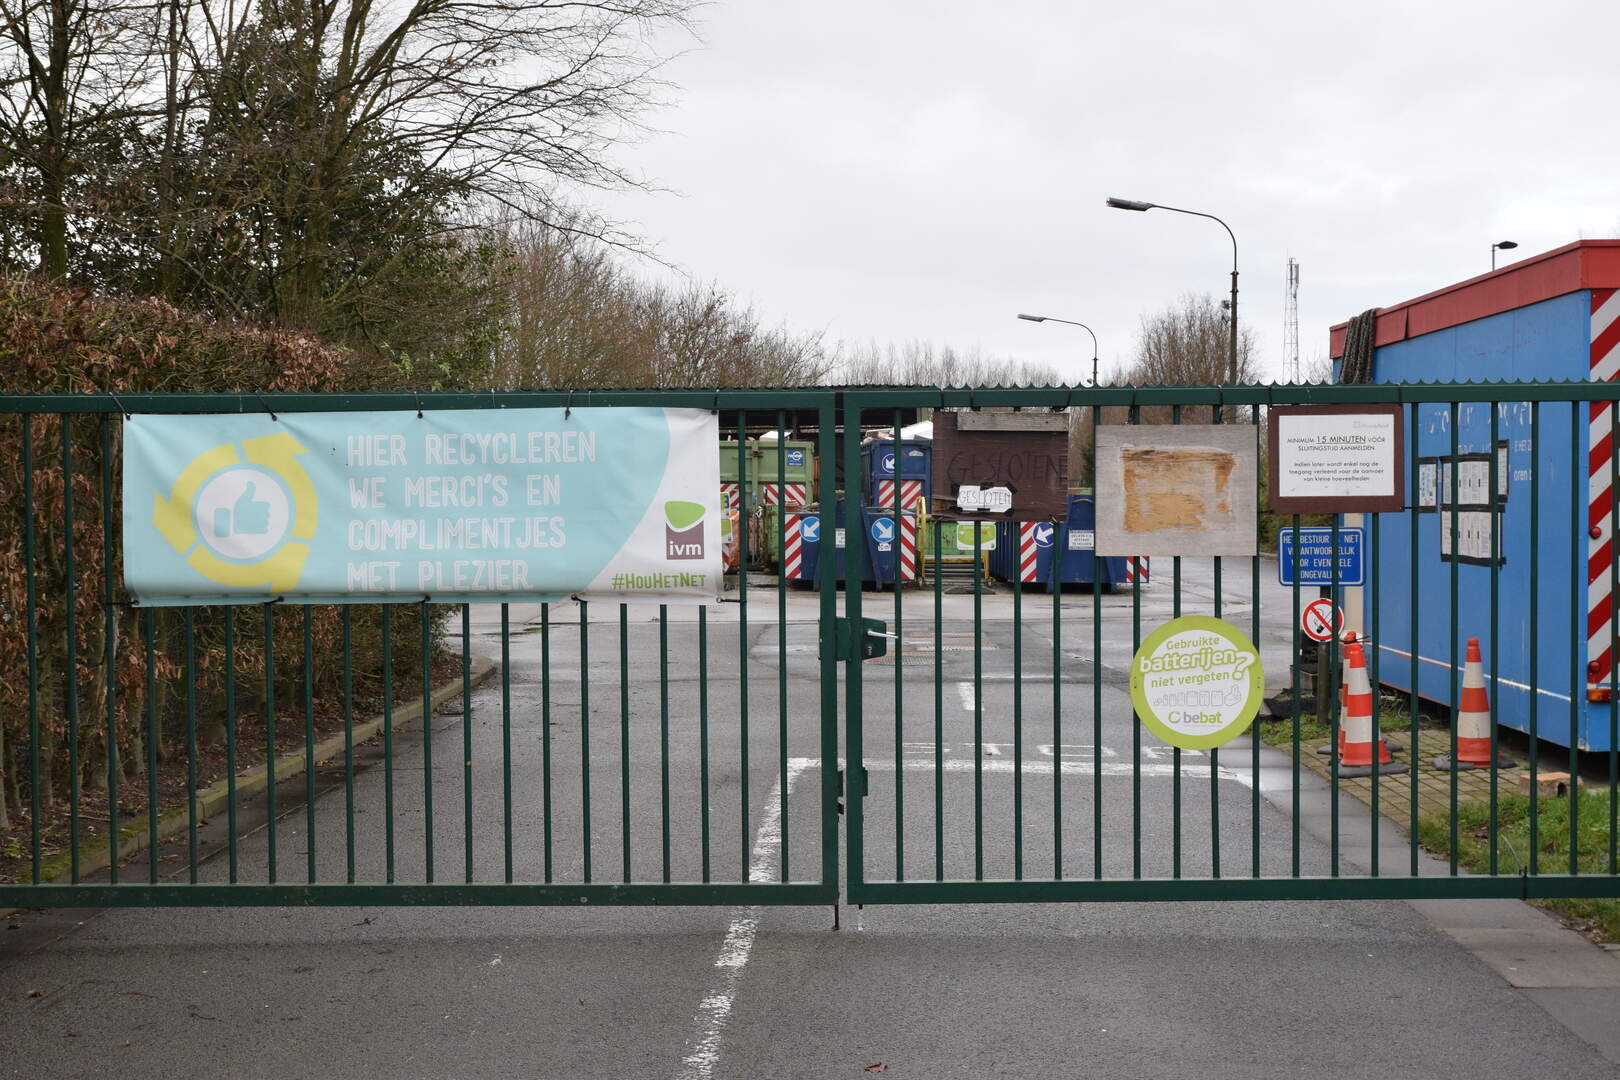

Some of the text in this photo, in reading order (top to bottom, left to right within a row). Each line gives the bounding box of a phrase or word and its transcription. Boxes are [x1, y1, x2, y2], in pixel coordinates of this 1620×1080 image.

[1317, 435, 1327, 443] 15
[1329, 435, 1367, 444] MINUTEN
[347, 431, 596, 467] HIER RECYCLEREN
[947, 450, 1064, 483] GESLOTEN
[349, 473, 561, 509] WE MERCI'S EN
[958, 489, 1012, 506] GESLOTEN
[348, 516, 566, 550] COMPLIMENTJES
[1300, 535, 1330, 544] BESTUUR
[1344, 534, 1359, 543] NIET
[669, 541, 701, 556] ivm
[1313, 558, 1352, 567] EVENELE
[347, 561, 400, 591] MET
[1166, 637, 1220, 650] Gebruikte
[1151, 671, 1230, 688] niet vergeten
[1183, 711, 1223, 724] bebat
